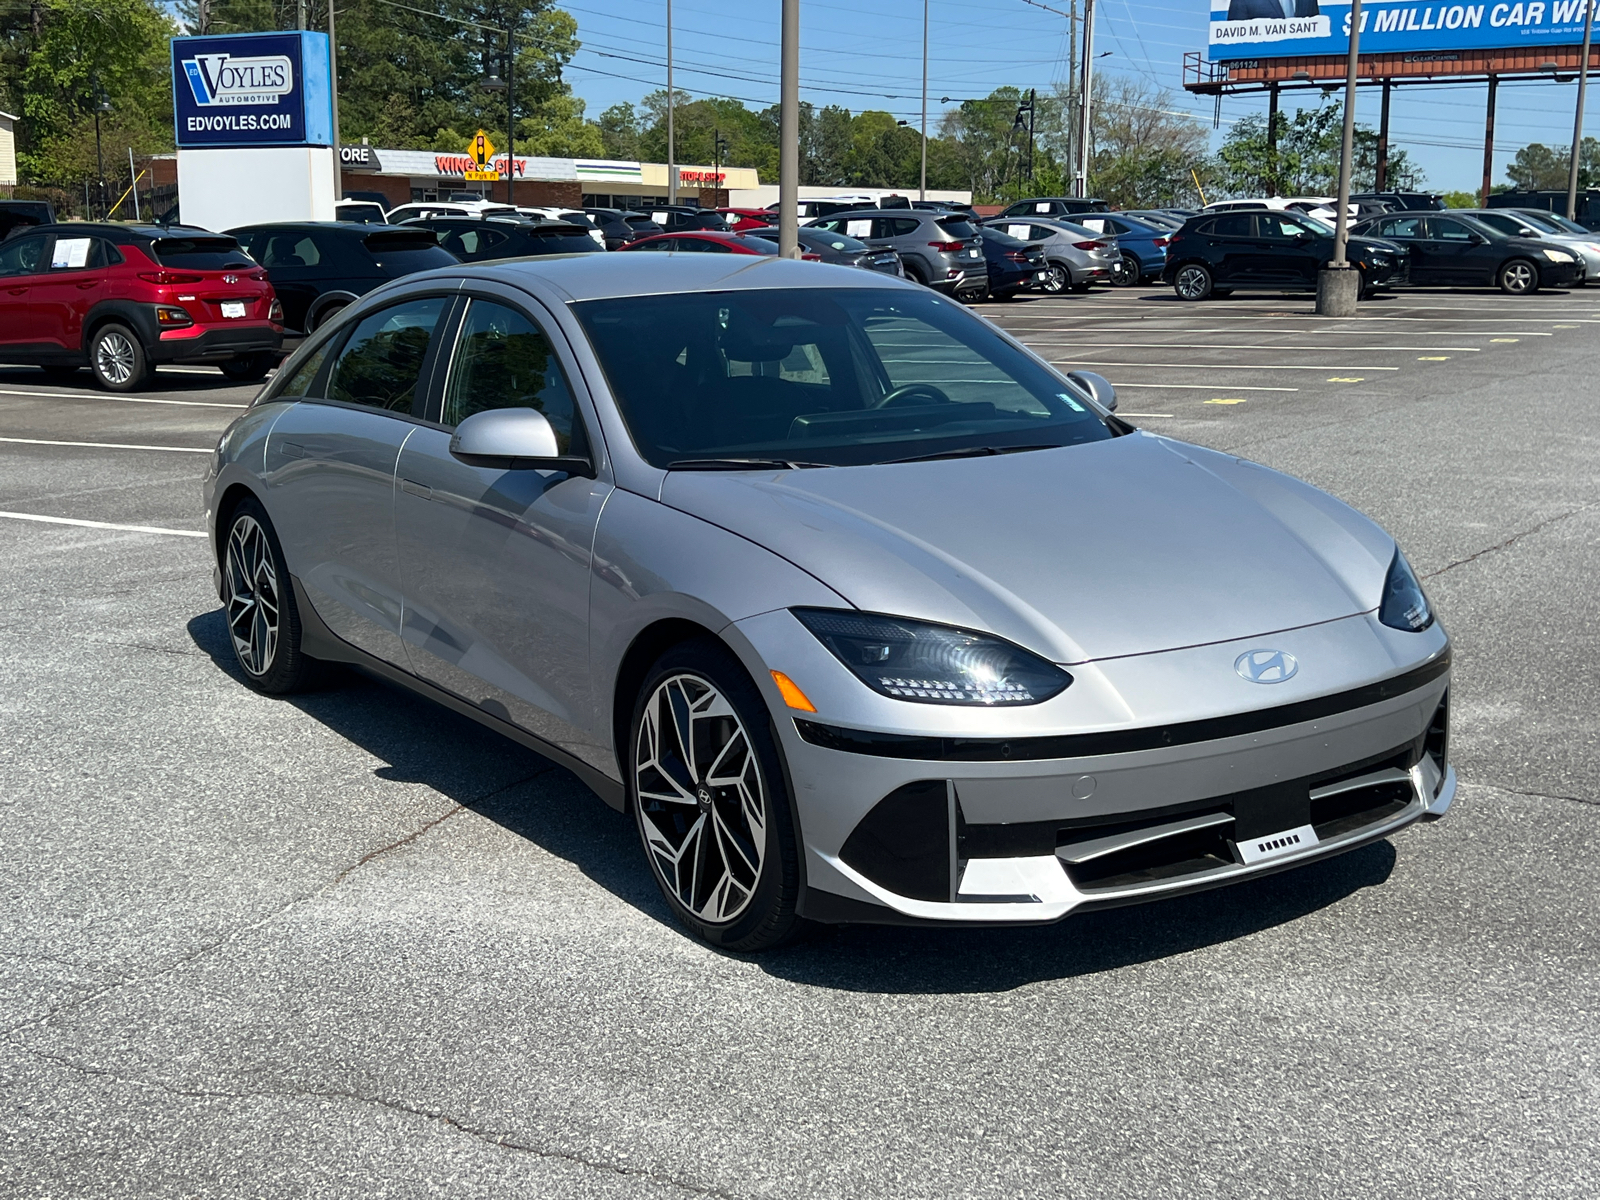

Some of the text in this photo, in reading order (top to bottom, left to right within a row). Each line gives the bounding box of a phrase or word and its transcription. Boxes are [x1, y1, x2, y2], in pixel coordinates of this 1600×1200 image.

[1373, 5, 1484, 33] MILLION
[1489, 2, 1546, 27] CAR
[1215, 22, 1319, 39] DAVID M. VAN SANT
[189, 68, 199, 76] ED
[197, 57, 285, 98] VOYLES
[218, 95, 277, 104] AUTOMOTIVE
[187, 114, 291, 131] EDVOYLES.COM
[339, 147, 369, 162] ORE
[435, 156, 477, 172] WING
